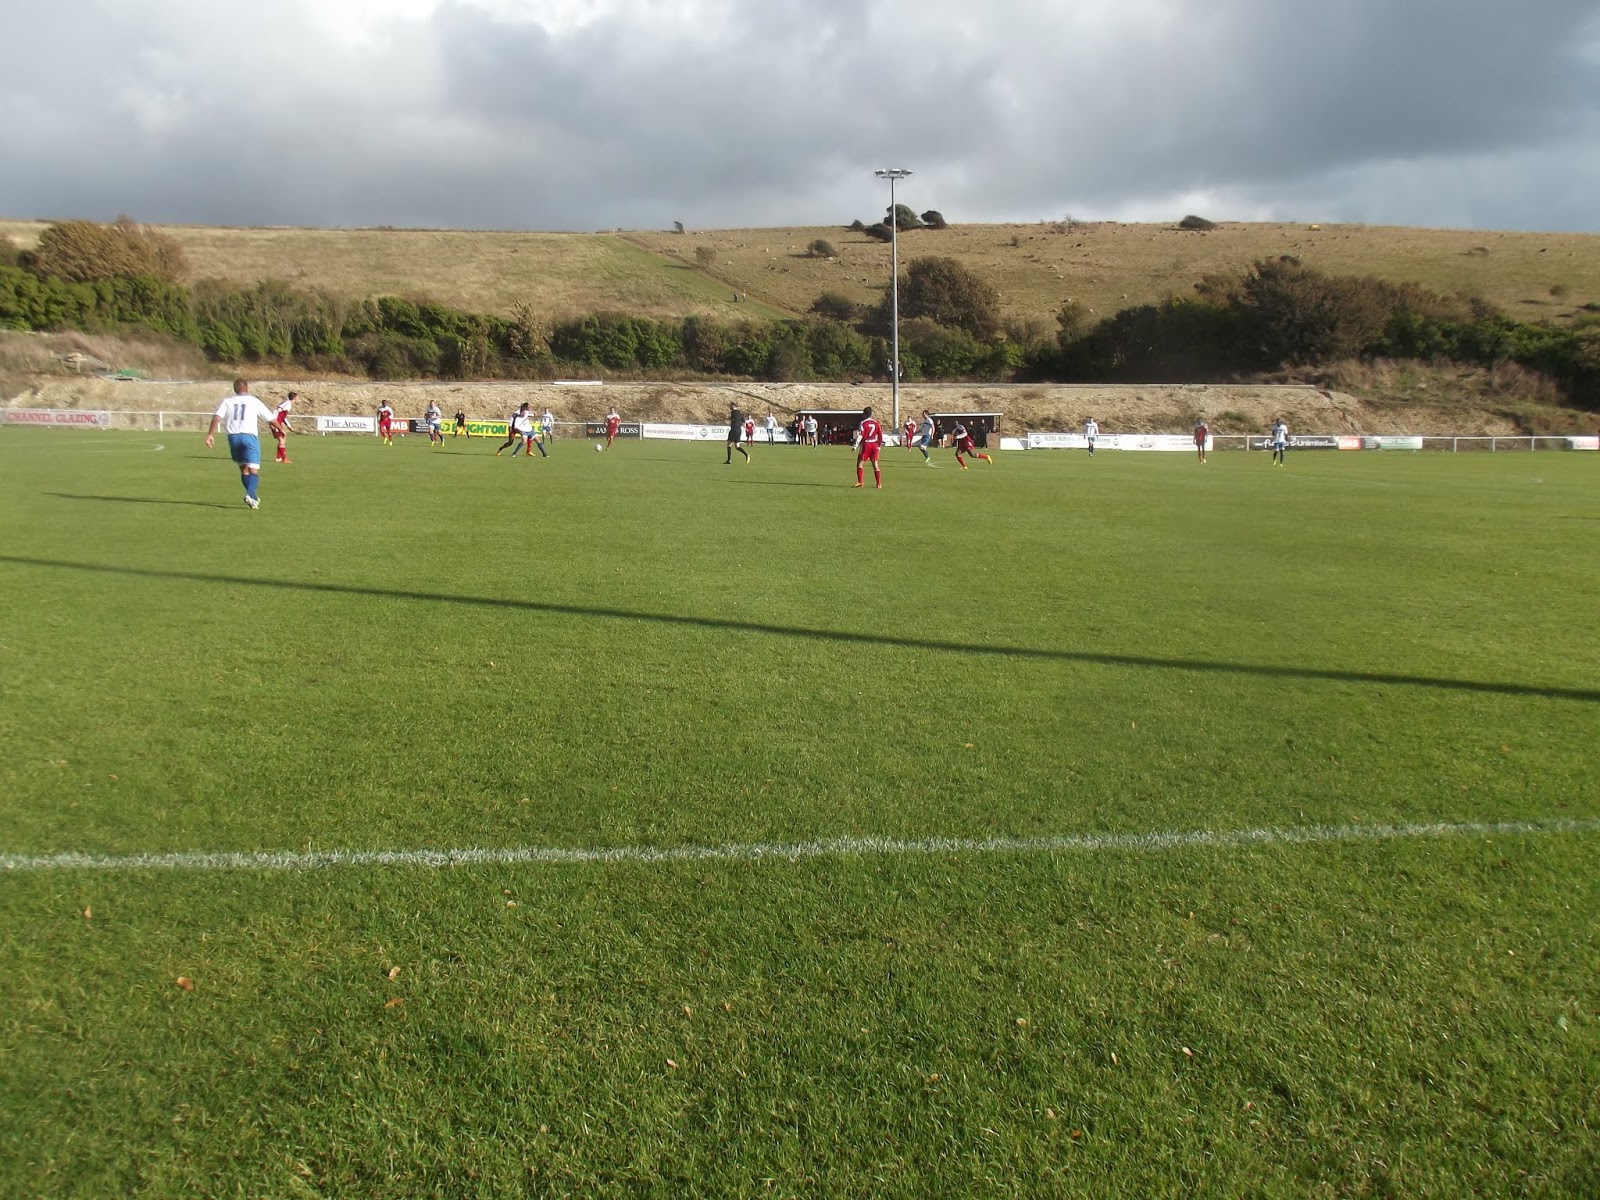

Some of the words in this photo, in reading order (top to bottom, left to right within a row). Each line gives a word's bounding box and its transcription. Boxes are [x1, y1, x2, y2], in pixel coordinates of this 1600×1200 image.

[8, 412, 52, 422] CHANNEL
[56, 413, 97, 424] GLAZING
[233, 403, 246, 421] 11
[325, 419, 341, 427] The
[344, 420, 367, 428] Argus
[389, 421, 408, 431] MB
[868, 423, 876, 437] 7
